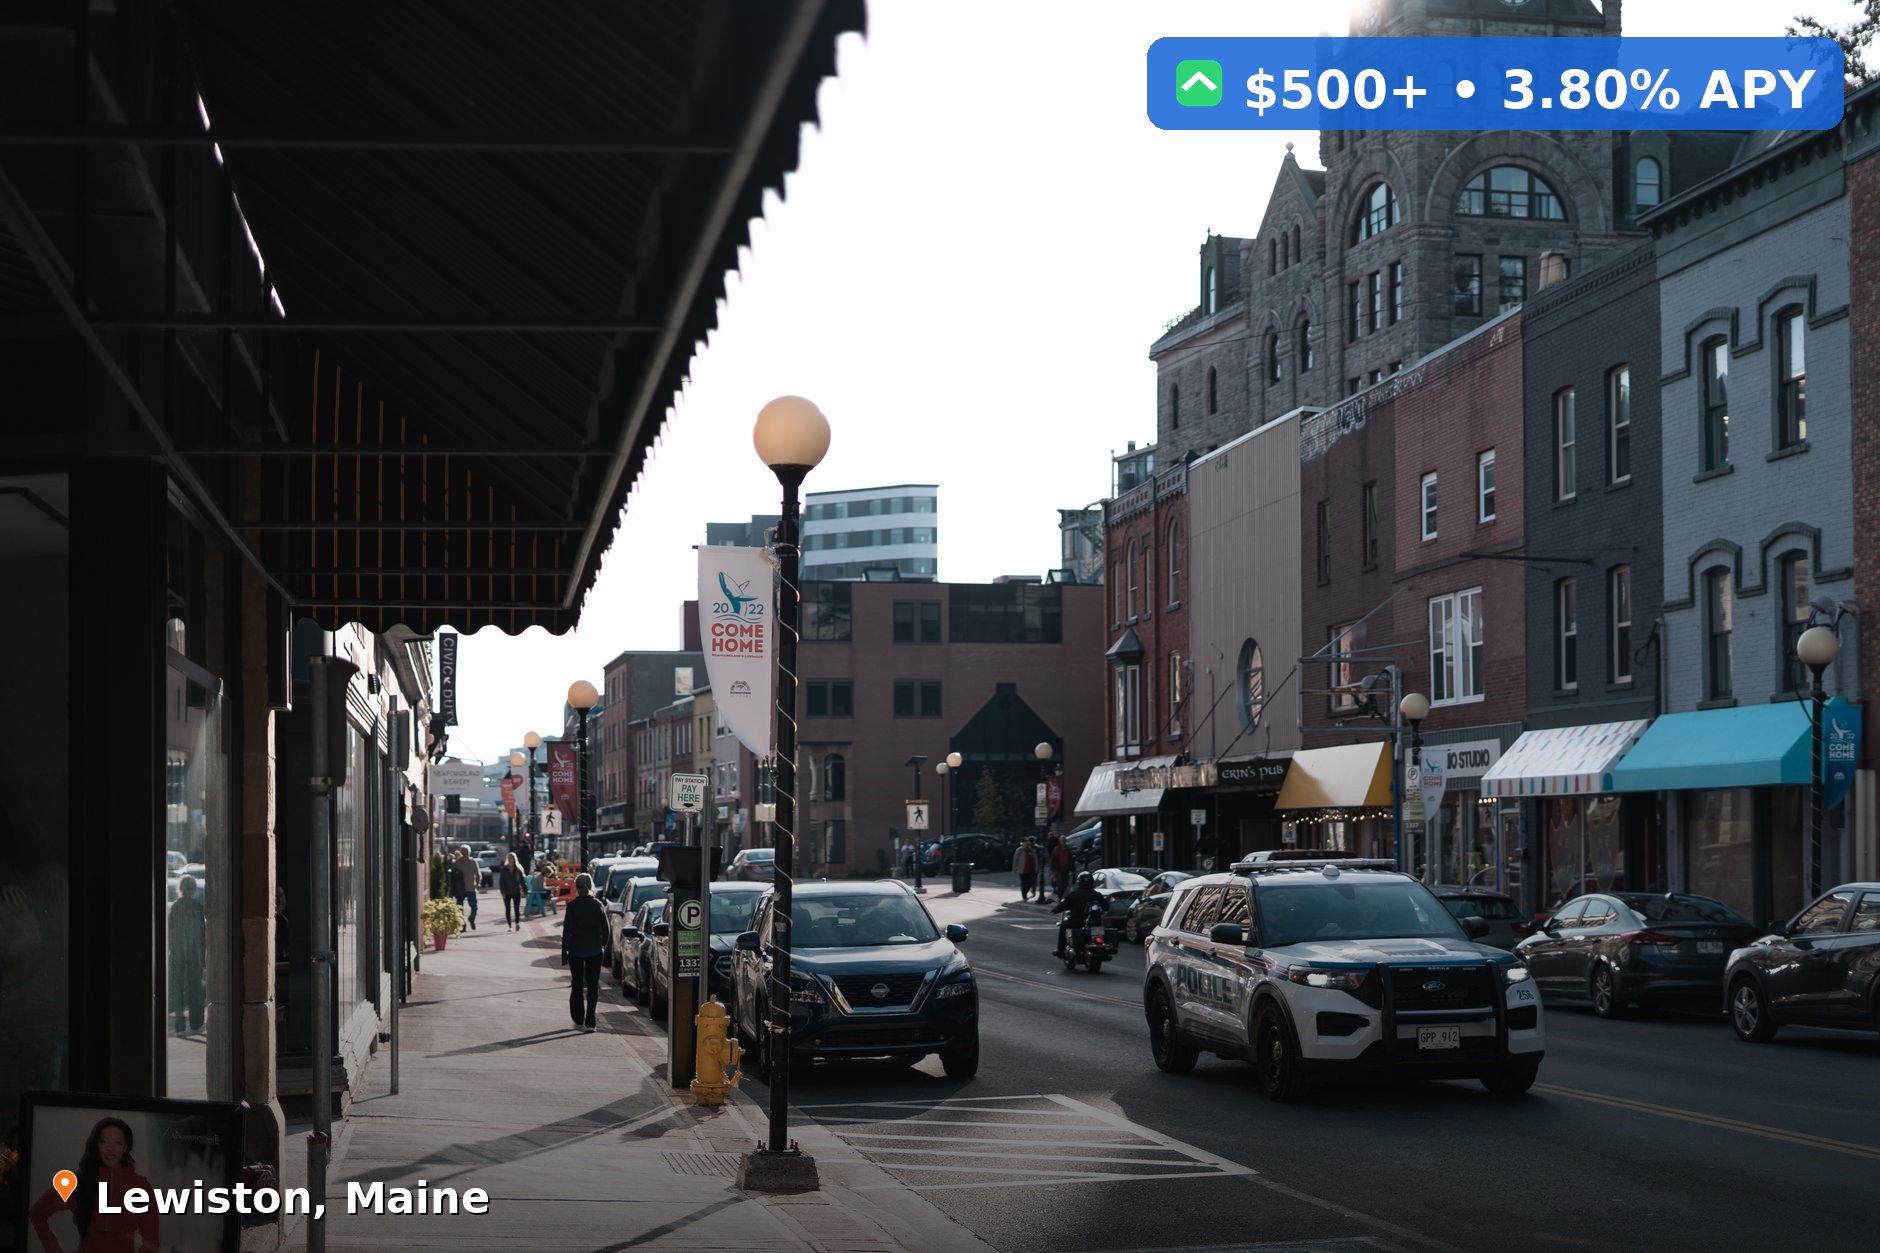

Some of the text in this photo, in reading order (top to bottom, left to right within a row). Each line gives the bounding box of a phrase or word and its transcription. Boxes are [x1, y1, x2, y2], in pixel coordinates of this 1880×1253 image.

[711, 622, 764, 638] COME
[711, 638, 764, 653] HOME
[442, 637, 455, 676] CIVIC
[1828, 743, 1855, 751] COME
[1458, 748, 1490, 769] STUDIO
[1829, 751, 1855, 759] HOME
[682, 784, 697, 793] PAY
[677, 793, 700, 803] HERE
[687, 906, 700, 924] P
[1177, 963, 1235, 1005] POLICE
[1516, 990, 1535, 1001] 256
[1420, 1031, 1458, 1043] GPP 912
